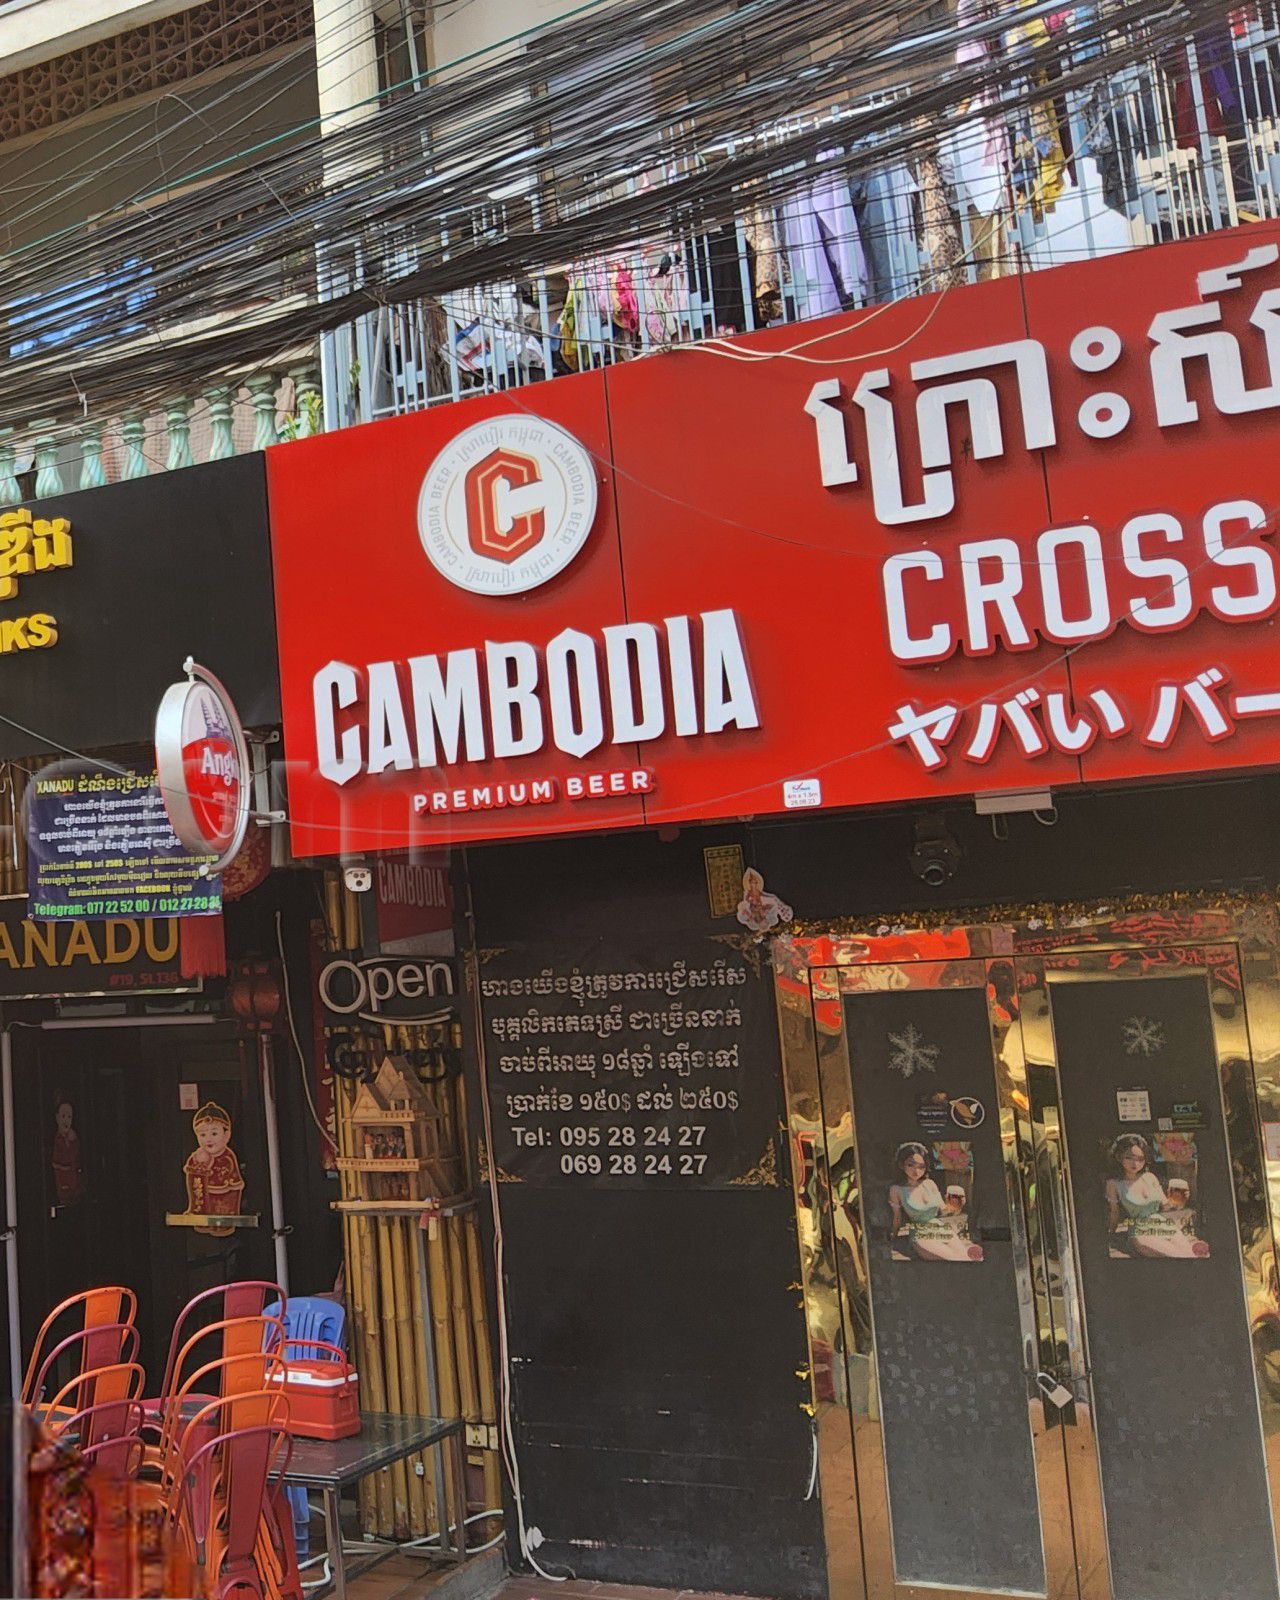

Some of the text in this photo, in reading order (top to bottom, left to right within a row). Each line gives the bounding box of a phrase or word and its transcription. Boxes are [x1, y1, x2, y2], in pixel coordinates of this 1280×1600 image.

[427, 466, 459, 567] CAMBODIA BEER
[552, 442, 586, 546] CAMBODIA BEER
[881, 499, 1277, 661] CROSS
[313, 608, 760, 786] CAMBODIA
[37, 778, 75, 794] XANADU
[414, 769, 651, 814] PREMIUM BEER
[87, 901, 105, 914] 077
[105, 901, 119, 913] 22
[120, 900, 134, 912] 52
[135, 899, 150, 912] 00
[159, 898, 179, 911] 012
[378, 858, 447, 908] CAMBODIA
[320, 960, 454, 1015] Open
[511, 1126, 707, 1147] Tel: 095 28 24 27
[560, 1154, 708, 1175] 069 28 24 27
